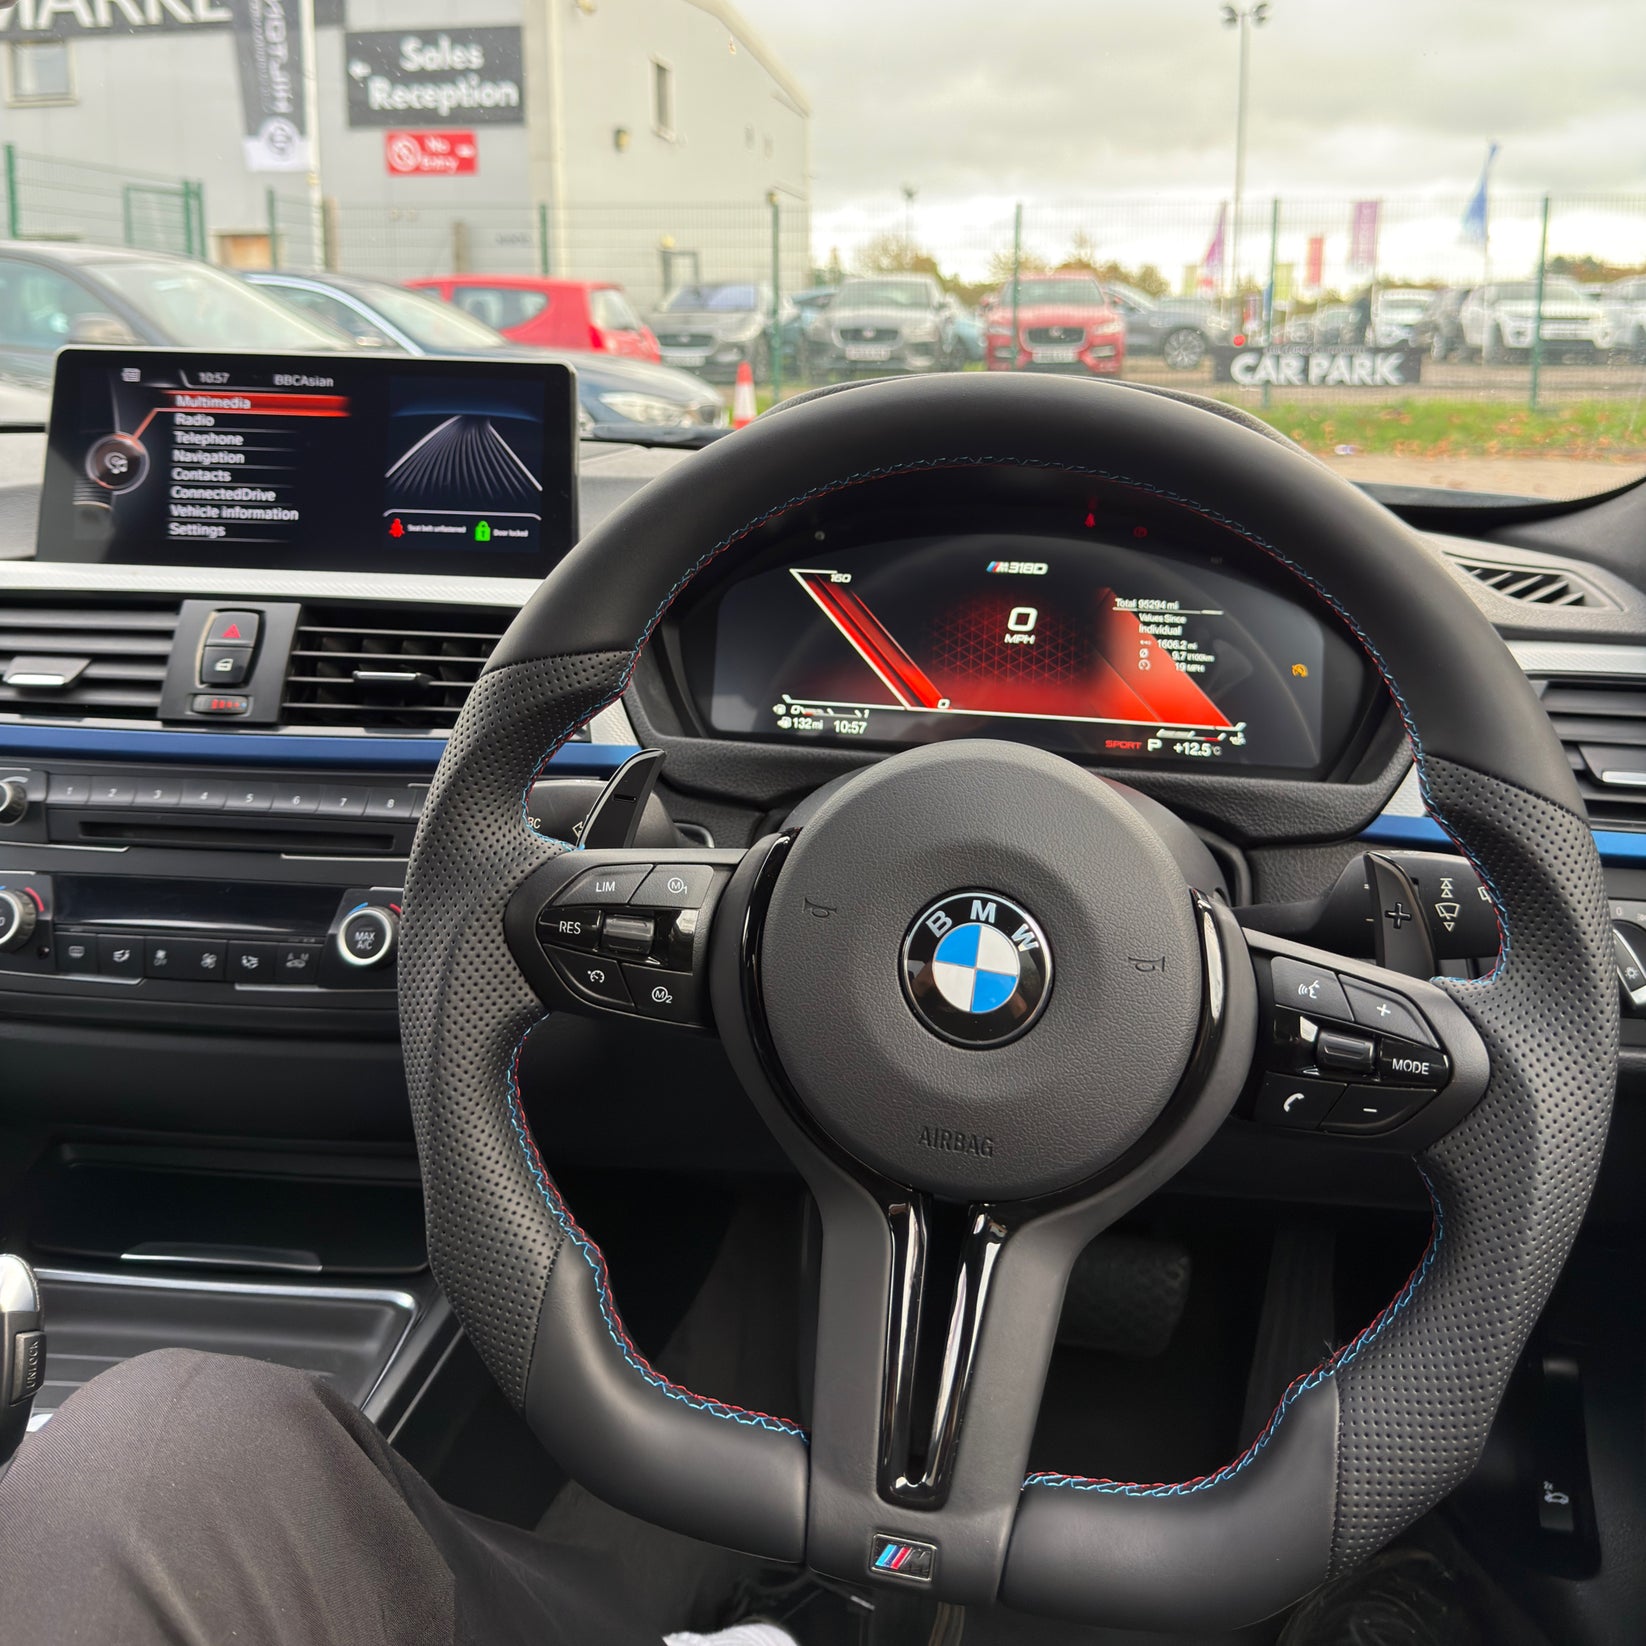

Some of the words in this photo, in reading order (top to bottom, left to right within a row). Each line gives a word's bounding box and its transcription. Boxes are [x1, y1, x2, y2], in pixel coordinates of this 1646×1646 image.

[400, 33, 485, 72] Sales
[368, 72, 520, 116] Reception
[1231, 352, 1301, 385] CAR
[1308, 352, 1405, 386] PARK
[199, 372, 229, 383] 10:57
[175, 395, 251, 409] Multimedia
[174, 413, 215, 427] Radio
[173, 431, 243, 446] Telephone
[173, 450, 245, 465] Navigation
[172, 467, 231, 482] Contacts
[170, 486, 276, 501] ConnectedDrive
[170, 504, 220, 518] Vehicle
[222, 506, 299, 521] information
[169, 523, 226, 538] Settings
[830, 573, 852, 583] 160
[1115, 597, 1137, 608] Total
[1007, 606, 1038, 632] 0
[1139, 624, 1183, 636] Individual
[1004, 633, 1036, 645] MPH
[833, 720, 868, 734] 10:57
[1105, 740, 1142, 749] SPORT
[1147, 738, 1163, 751] P
[595, 881, 616, 892] LIM
[559, 920, 581, 935] RES
[925, 899, 1040, 953] BMW
[354, 931, 376, 940] MAX
[356, 940, 373, 950] A/C
[1391, 1057, 1430, 1076] MODE
[918, 1126, 994, 1159] AIRBAG
[26, 1340, 39, 1389] UNLOCK
